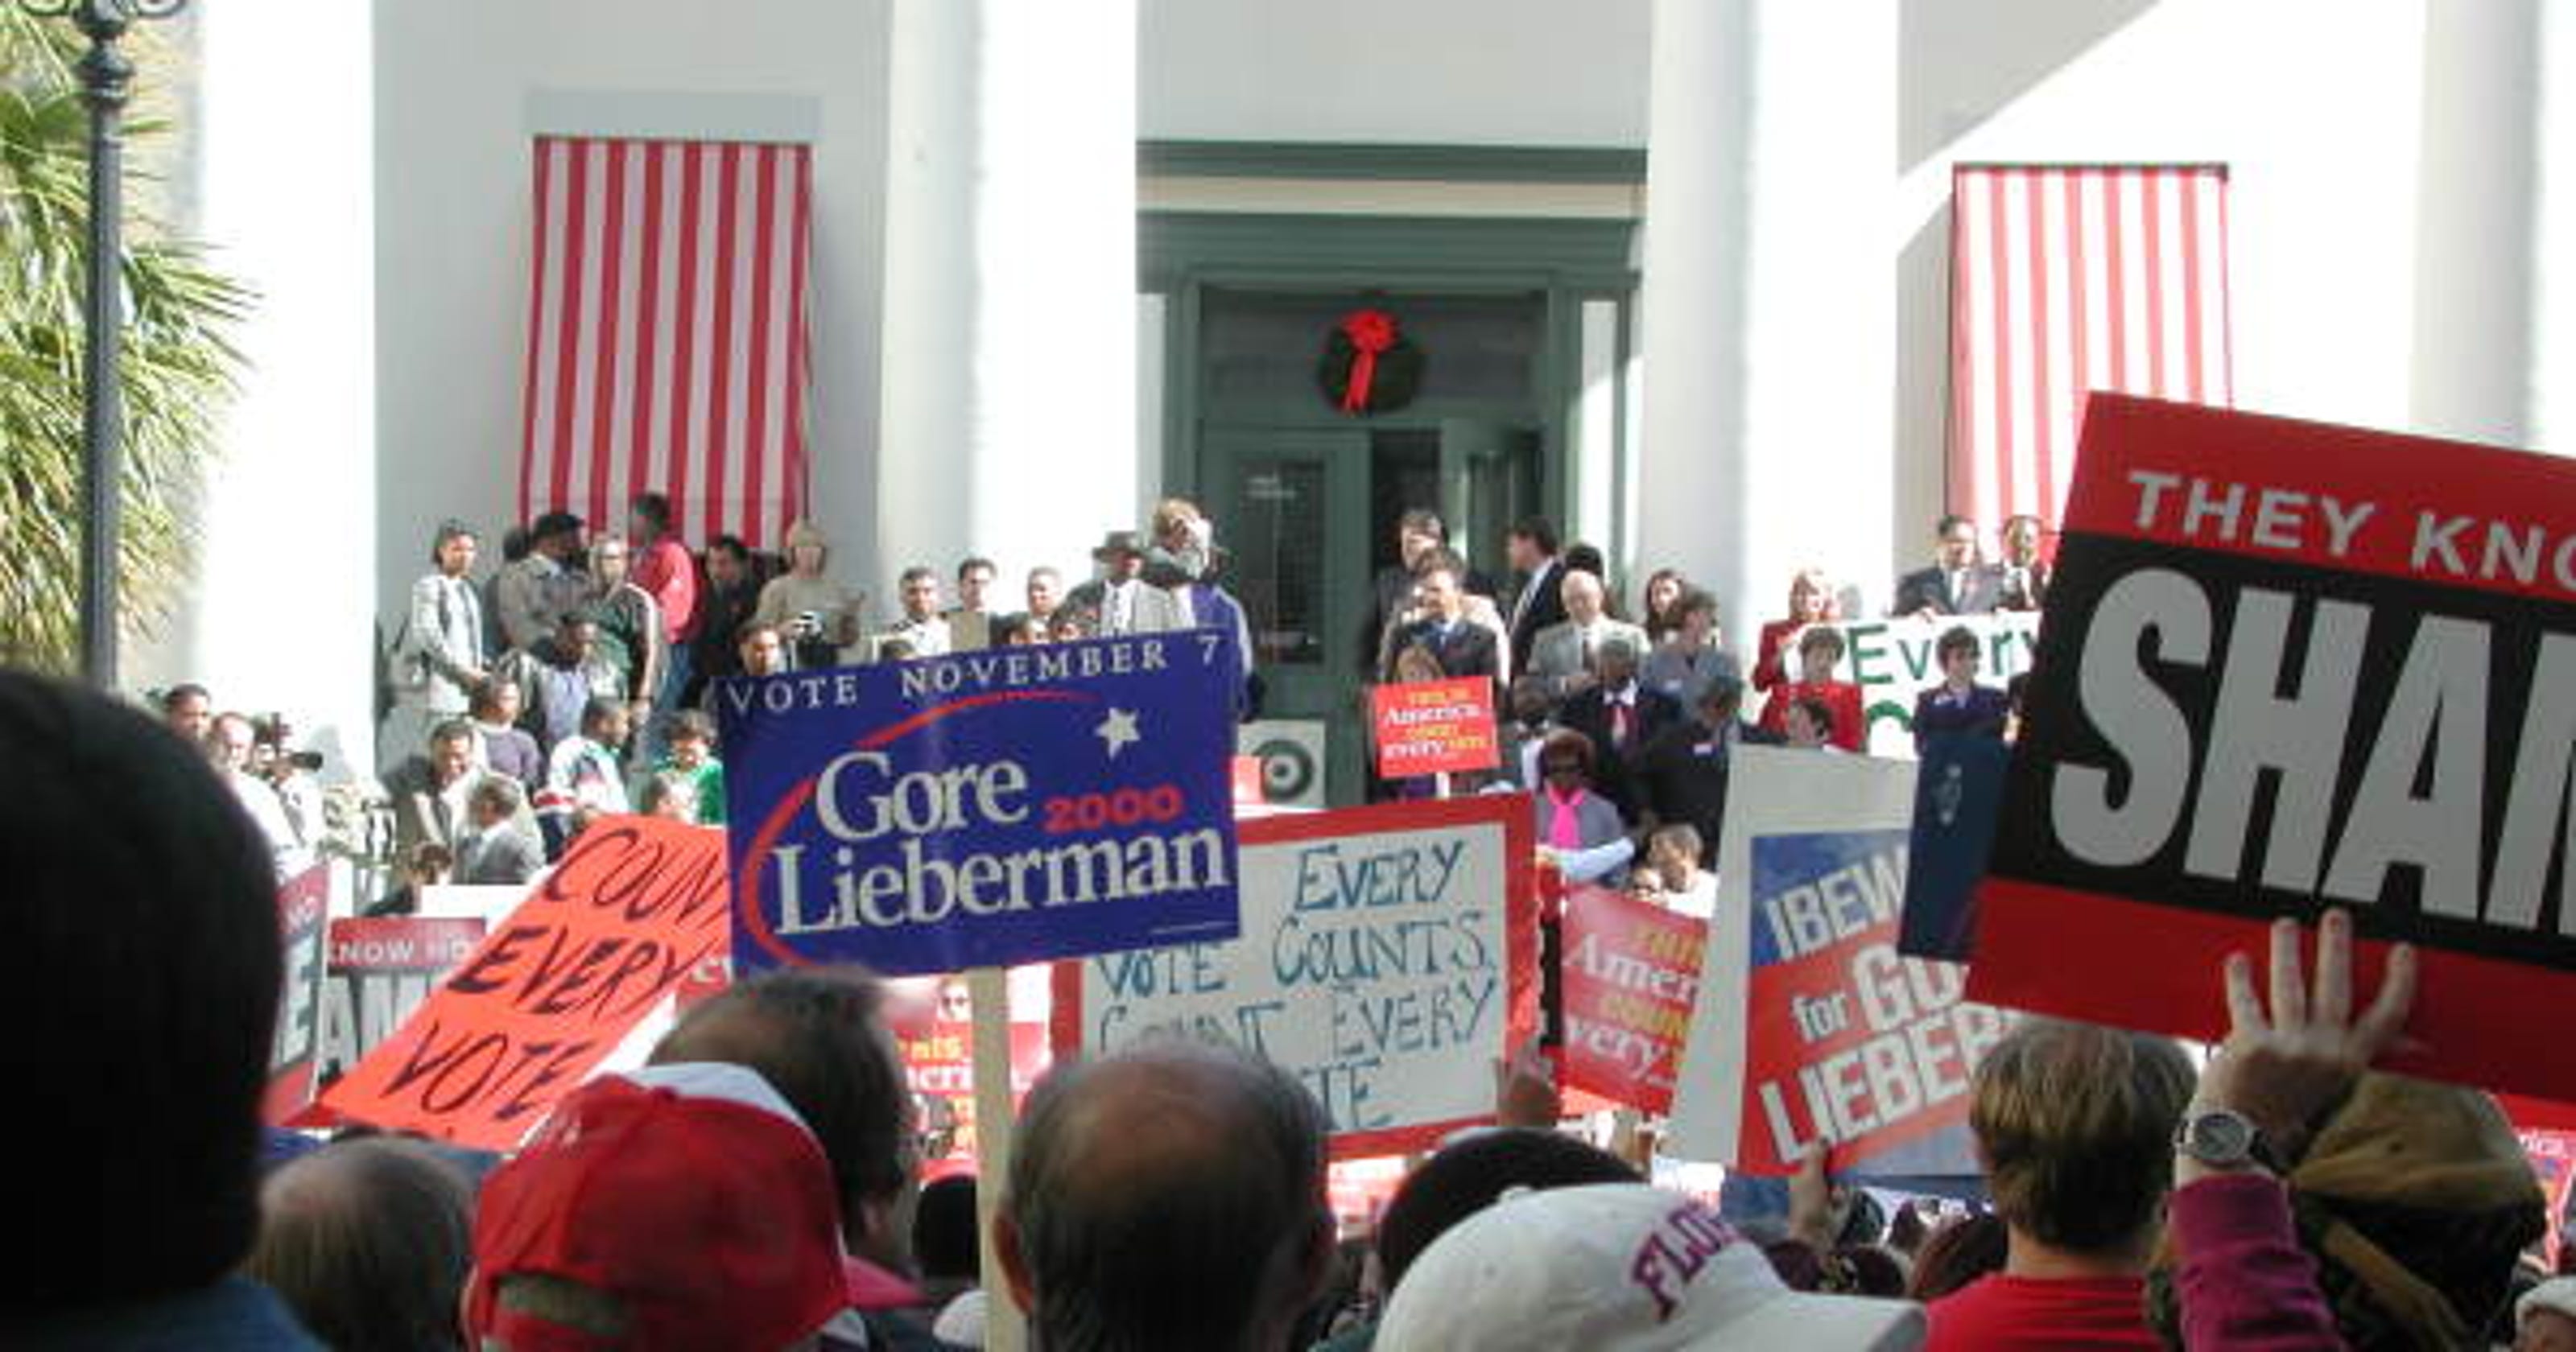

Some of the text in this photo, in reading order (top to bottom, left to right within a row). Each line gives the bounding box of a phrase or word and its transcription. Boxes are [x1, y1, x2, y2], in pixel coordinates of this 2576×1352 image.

[2129, 469, 2576, 592] THEY KN
[727, 636, 1218, 713] VOTE NOVEMBER 7
[815, 750, 1184, 843] Gore 2000
[773, 826, 1231, 937] Lieberman
[1294, 839, 1465, 913] EVERY
[1765, 842, 1910, 961] IBEW
[322, 938, 415, 966] NOW
[446, 925, 715, 1016] EVERY
[1564, 932, 1700, 1006] Amer
[1331, 976, 1495, 1056] EVERY
[1564, 1014, 1668, 1080] very
[1793, 991, 1847, 1043] for
[378, 1022, 596, 1119] VOTE
[1760, 1000, 2013, 1164] LIEBER
